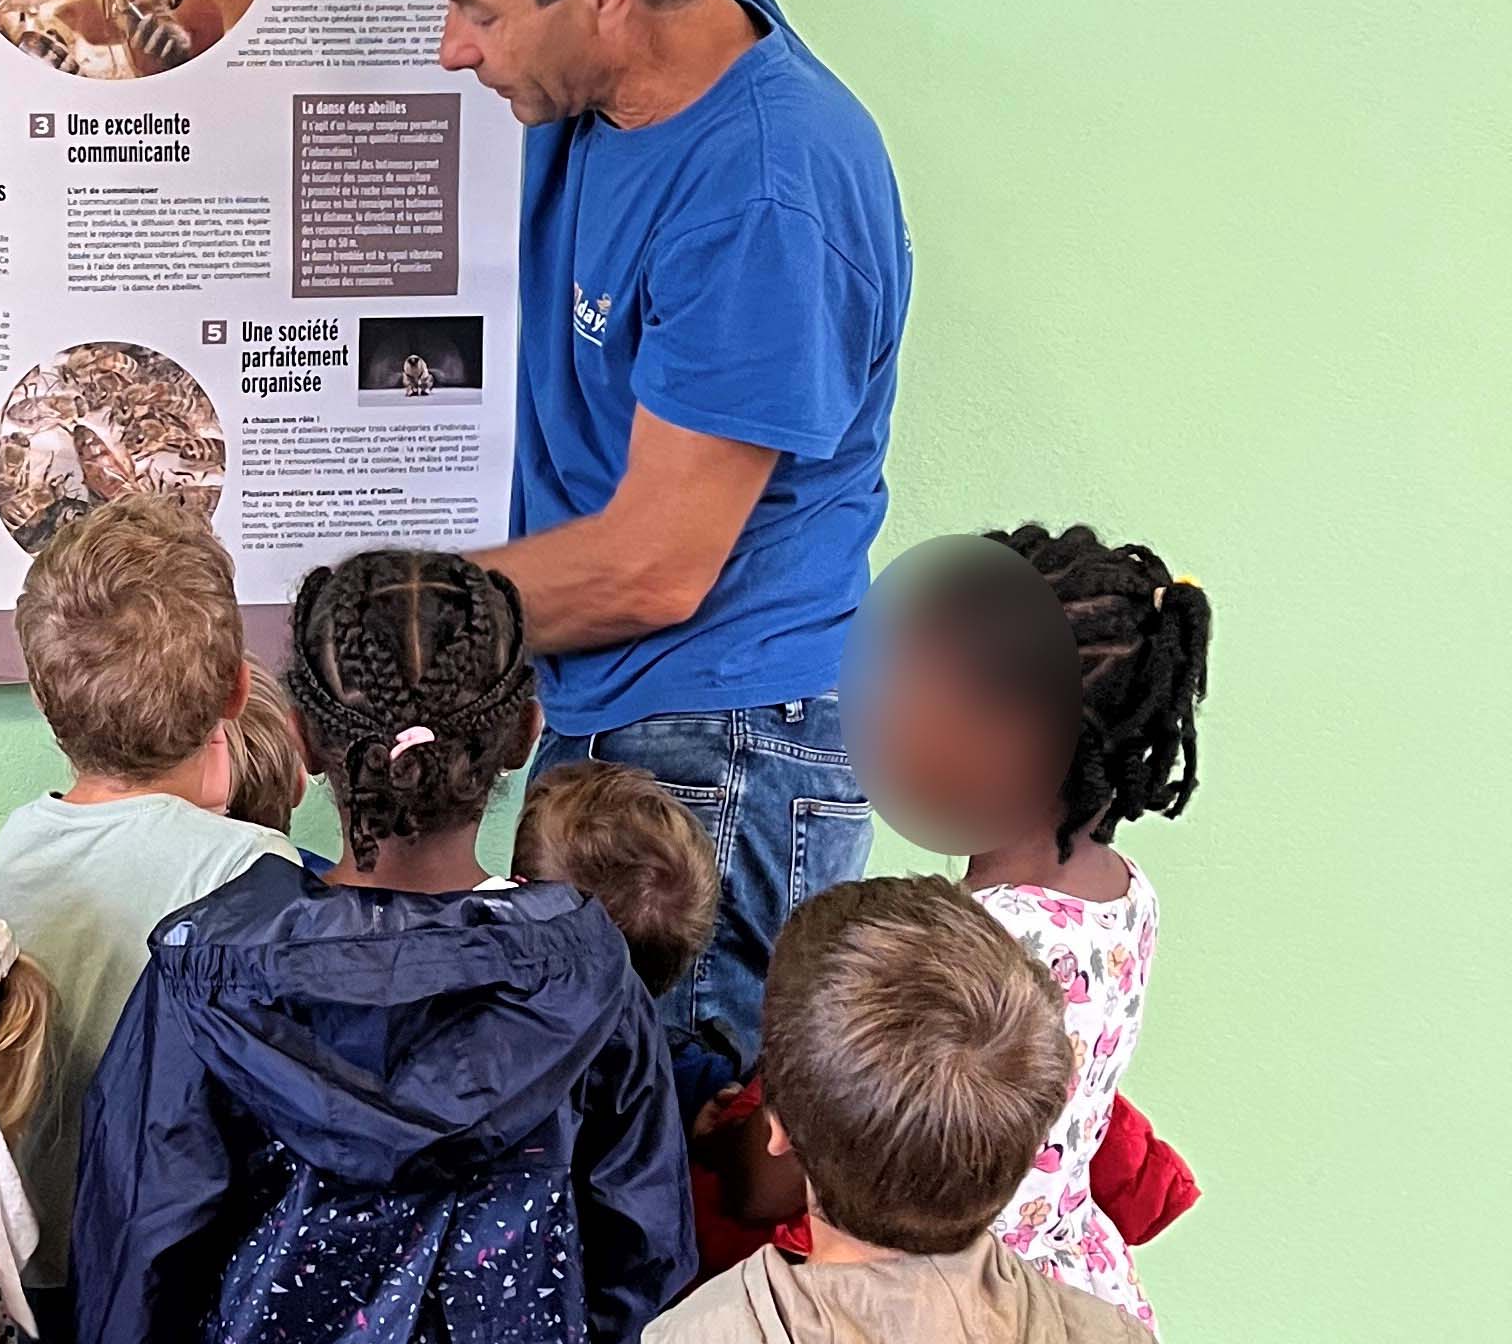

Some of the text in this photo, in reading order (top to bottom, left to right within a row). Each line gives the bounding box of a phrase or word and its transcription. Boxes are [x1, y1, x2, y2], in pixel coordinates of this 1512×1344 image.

[301, 100, 406, 114] La danse des abeilles
[35, 116, 50, 135] 3
[67, 113, 98, 135] Une
[67, 139, 190, 163] communicante
[207, 318, 338, 342] 5 Une société
[241, 344, 348, 373] parfaitement
[241, 368, 321, 398] organisée
